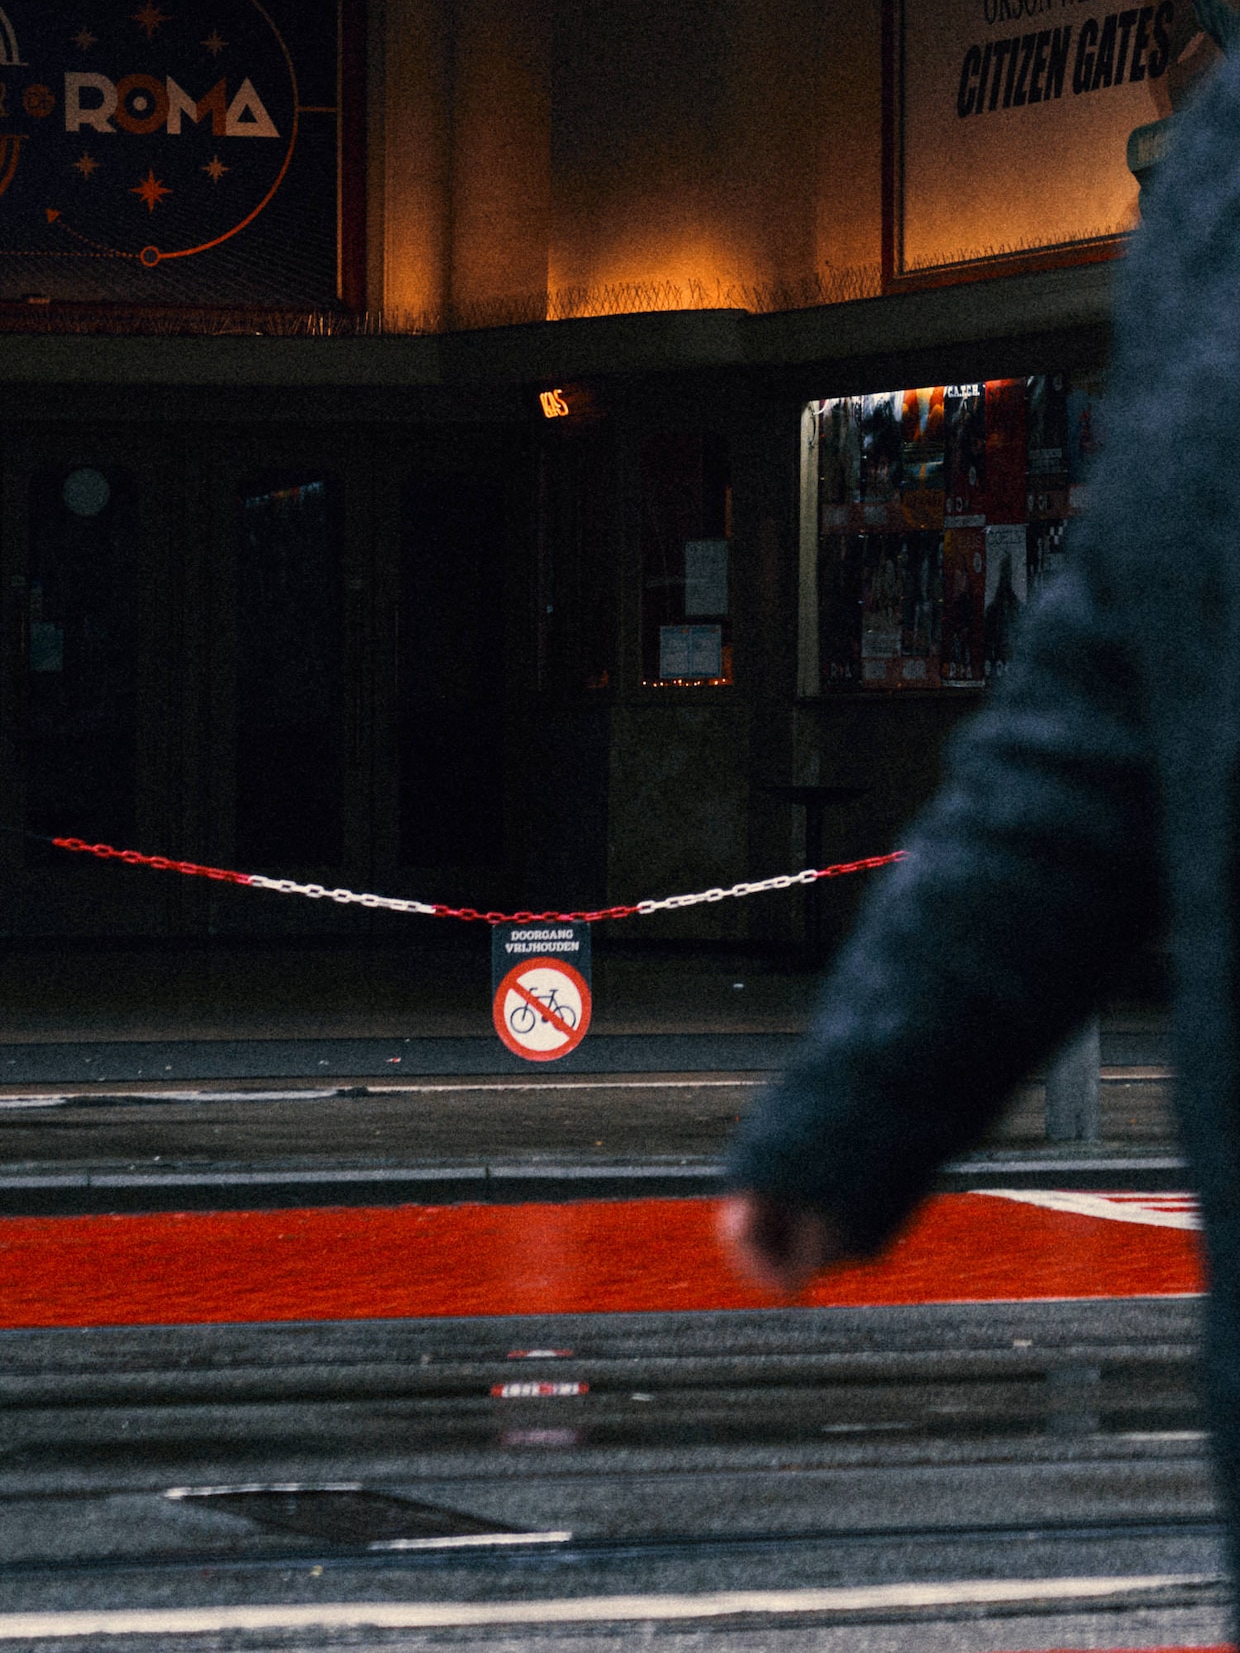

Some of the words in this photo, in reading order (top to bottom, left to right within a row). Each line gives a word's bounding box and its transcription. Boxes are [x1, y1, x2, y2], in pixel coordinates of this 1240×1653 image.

[957, 25, 1072, 119] CITIZEN
[1073, 0, 1175, 95] GATES
[63, 71, 282, 139] ROMA
[505, 941, 580, 953] VRIJHOUDEN
[511, 929, 574, 941] DOORGANG
